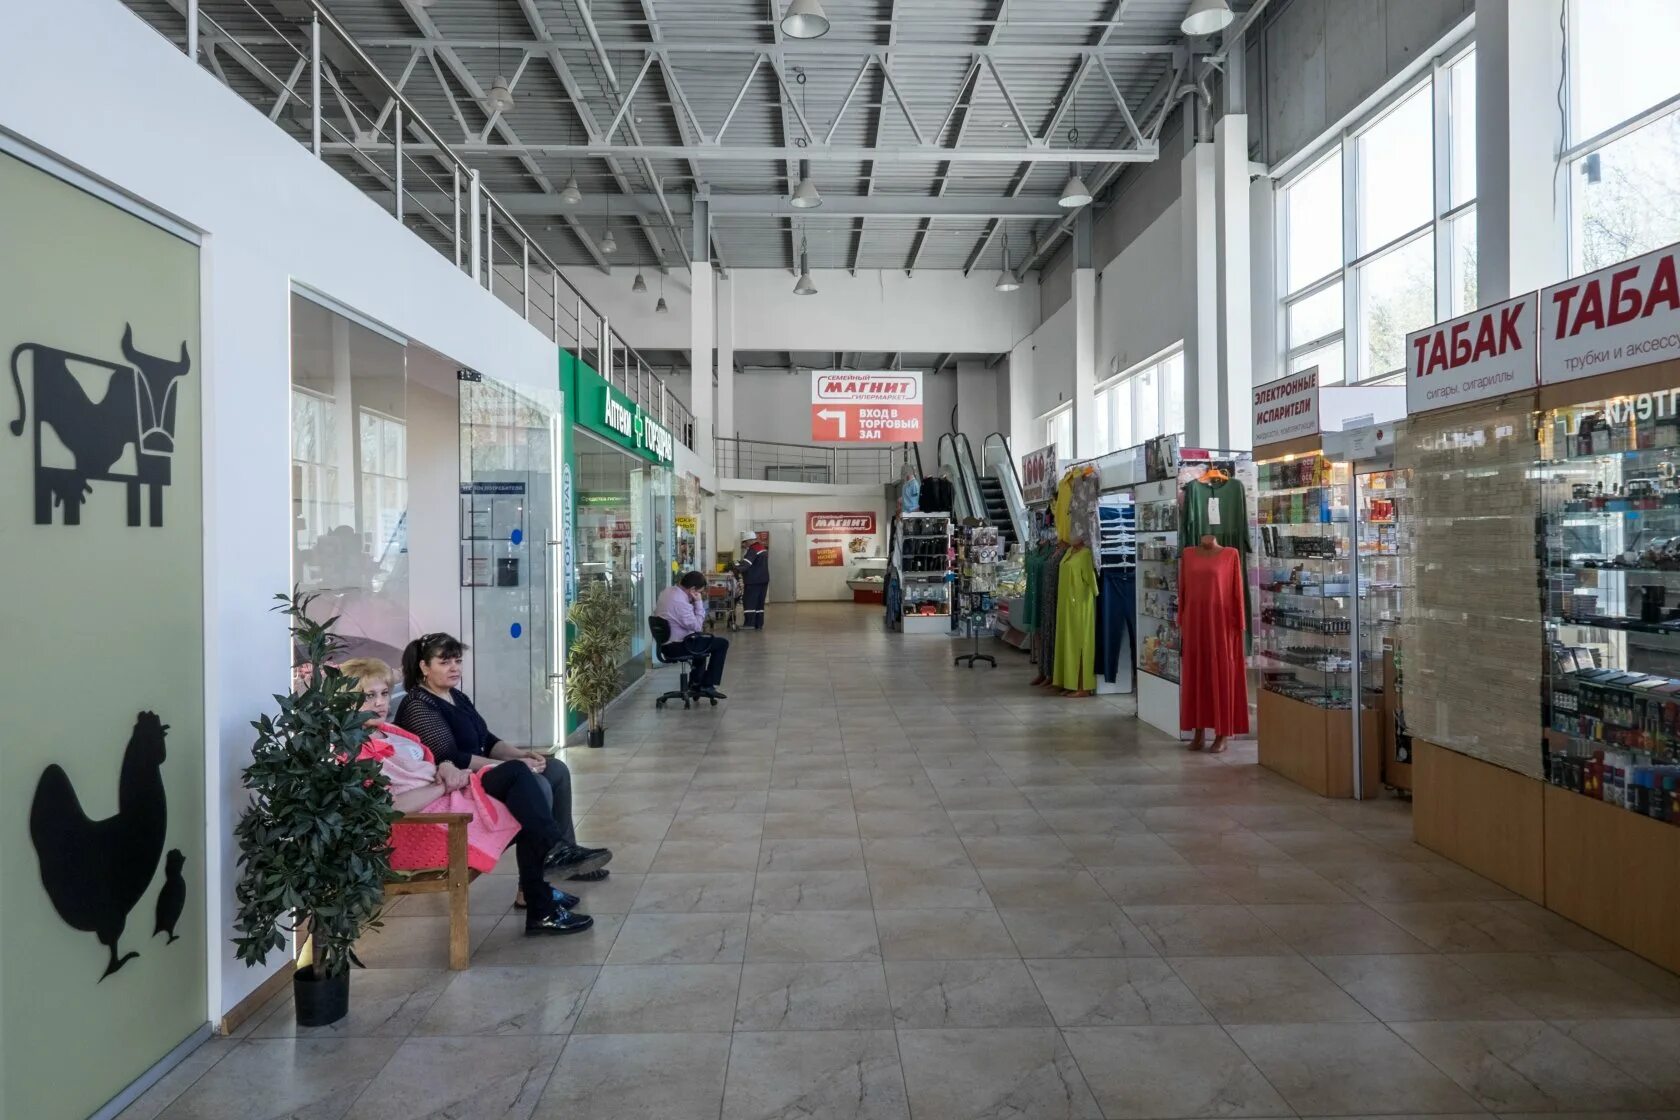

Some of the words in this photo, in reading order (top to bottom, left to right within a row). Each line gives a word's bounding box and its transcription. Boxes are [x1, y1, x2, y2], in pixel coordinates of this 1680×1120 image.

[1414, 301, 1526, 378] ТАБАК
[1564, 348, 1610, 371] трубки
[1613, 346, 1622, 360] и
[824, 382, 910, 393] МАГНИТ
[1254, 373, 1316, 406] ЭЛЕКТРОННЫЕ
[1462, 369, 1514, 393] сигариллы
[859, 409, 889, 420] ВХОД
[891, 409, 897, 418] В
[859, 417, 919, 429] ТОРГОВЫЙ
[1256, 397, 1311, 425] ИСПАРИТЕЛИ
[859, 430, 881, 439] ЗАЛ
[564, 472, 573, 577] ГОРЗДРАВ
[815, 518, 868, 527] МАГНИТ
